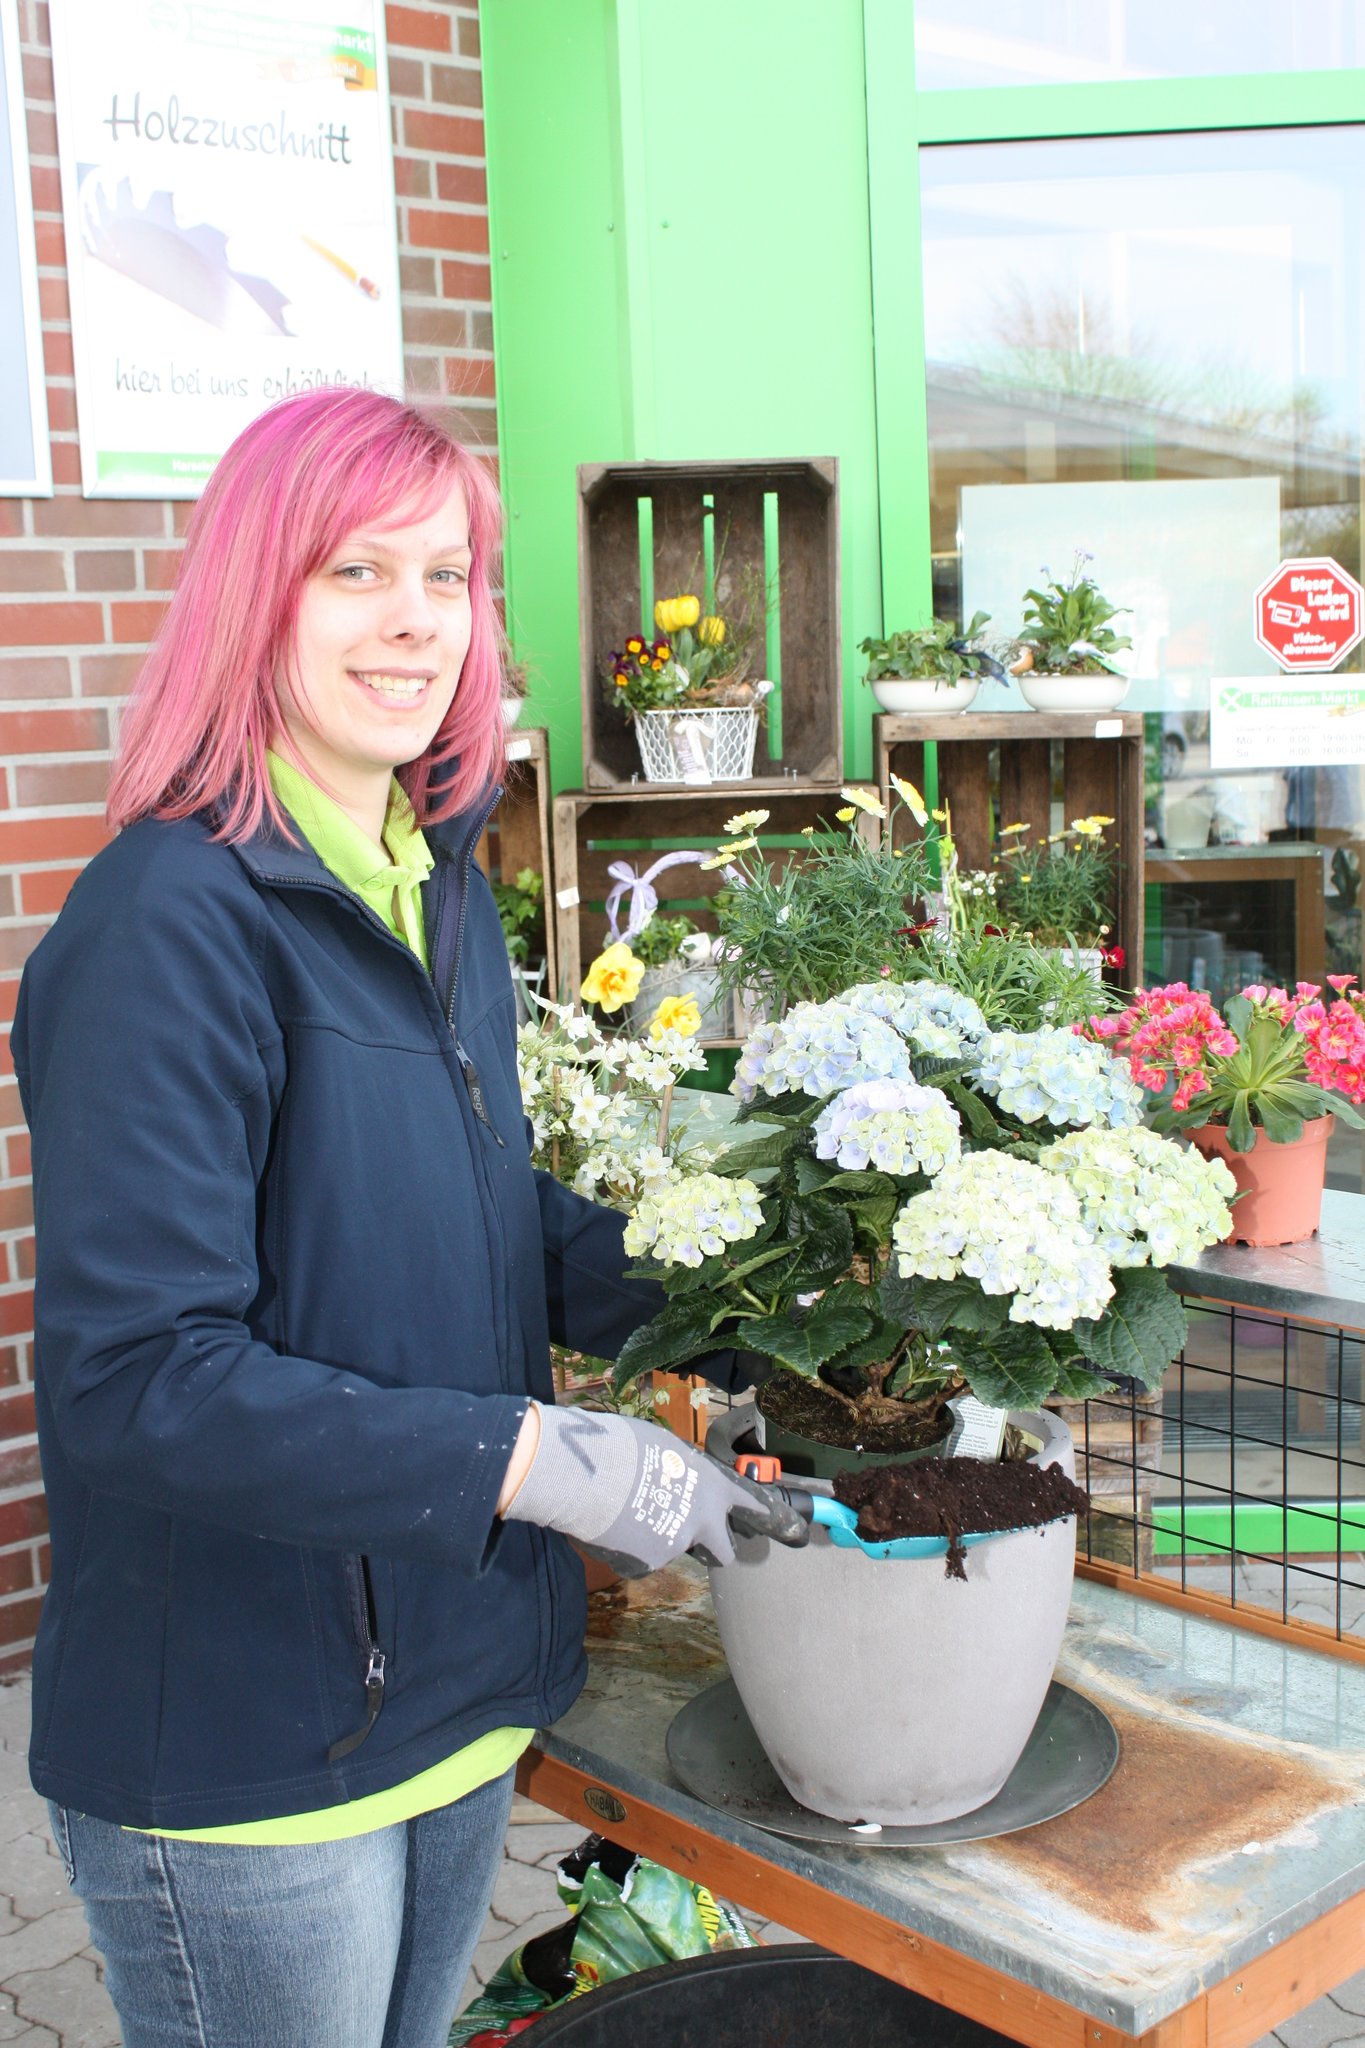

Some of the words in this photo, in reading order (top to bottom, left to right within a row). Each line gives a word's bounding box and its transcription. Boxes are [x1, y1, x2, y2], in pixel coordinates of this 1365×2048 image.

[103, 91, 352, 164] Holzzuschnitt
[115, 357, 162, 393] hier
[170, 361, 201, 395] bei
[210, 378, 249, 398] uns
[1290, 576, 1335, 592] Dieser
[1307, 590, 1350, 607] Laden
[1318, 605, 1350, 621] wird
[1293, 631, 1326, 645] Video-
